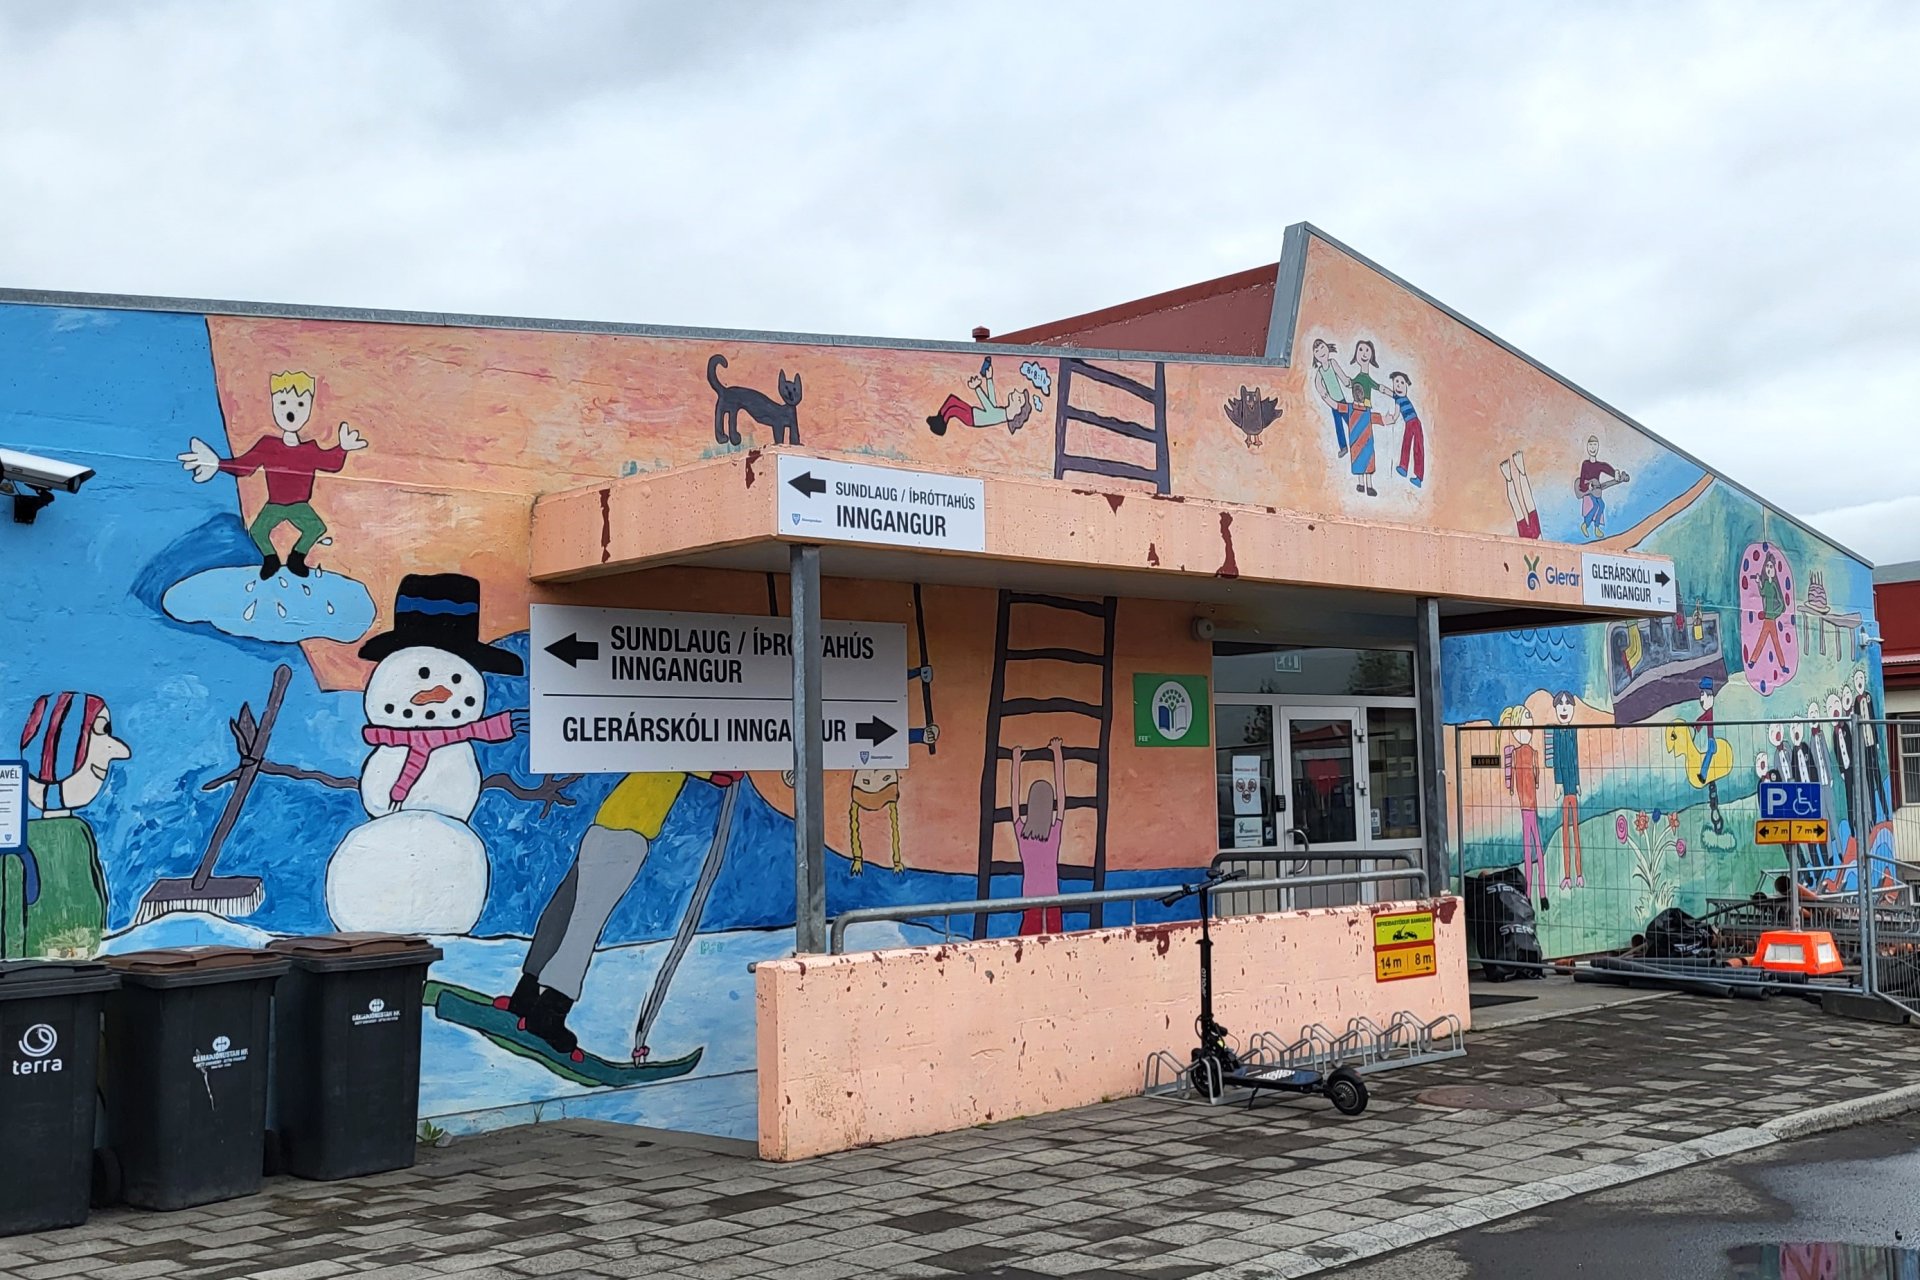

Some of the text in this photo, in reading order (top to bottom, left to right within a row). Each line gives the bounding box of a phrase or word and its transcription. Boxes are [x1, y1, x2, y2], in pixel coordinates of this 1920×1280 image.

[835, 481, 976, 510] SUNDLAUG / ÍÞRÓTTAHÚS
[836, 504, 947, 537] INNGANGUR
[1591, 563, 1651, 584] GLERÁRSKÓLI
[1601, 583, 1652, 603] INNGANGUR
[610, 625, 874, 660] SUNDLAUG / ÍÞRAHÚS
[611, 655, 742, 683] INNGANGUR
[562, 711, 847, 743] GLERÁRSKÓLI INNGAUR
[1767, 788, 1788, 815] P
[1772, 826, 1779, 836] 7
[1796, 825, 1803, 834] 7
[1380, 952, 1432, 970] 14 m 8 m
[12, 1058, 63, 1075] terra
